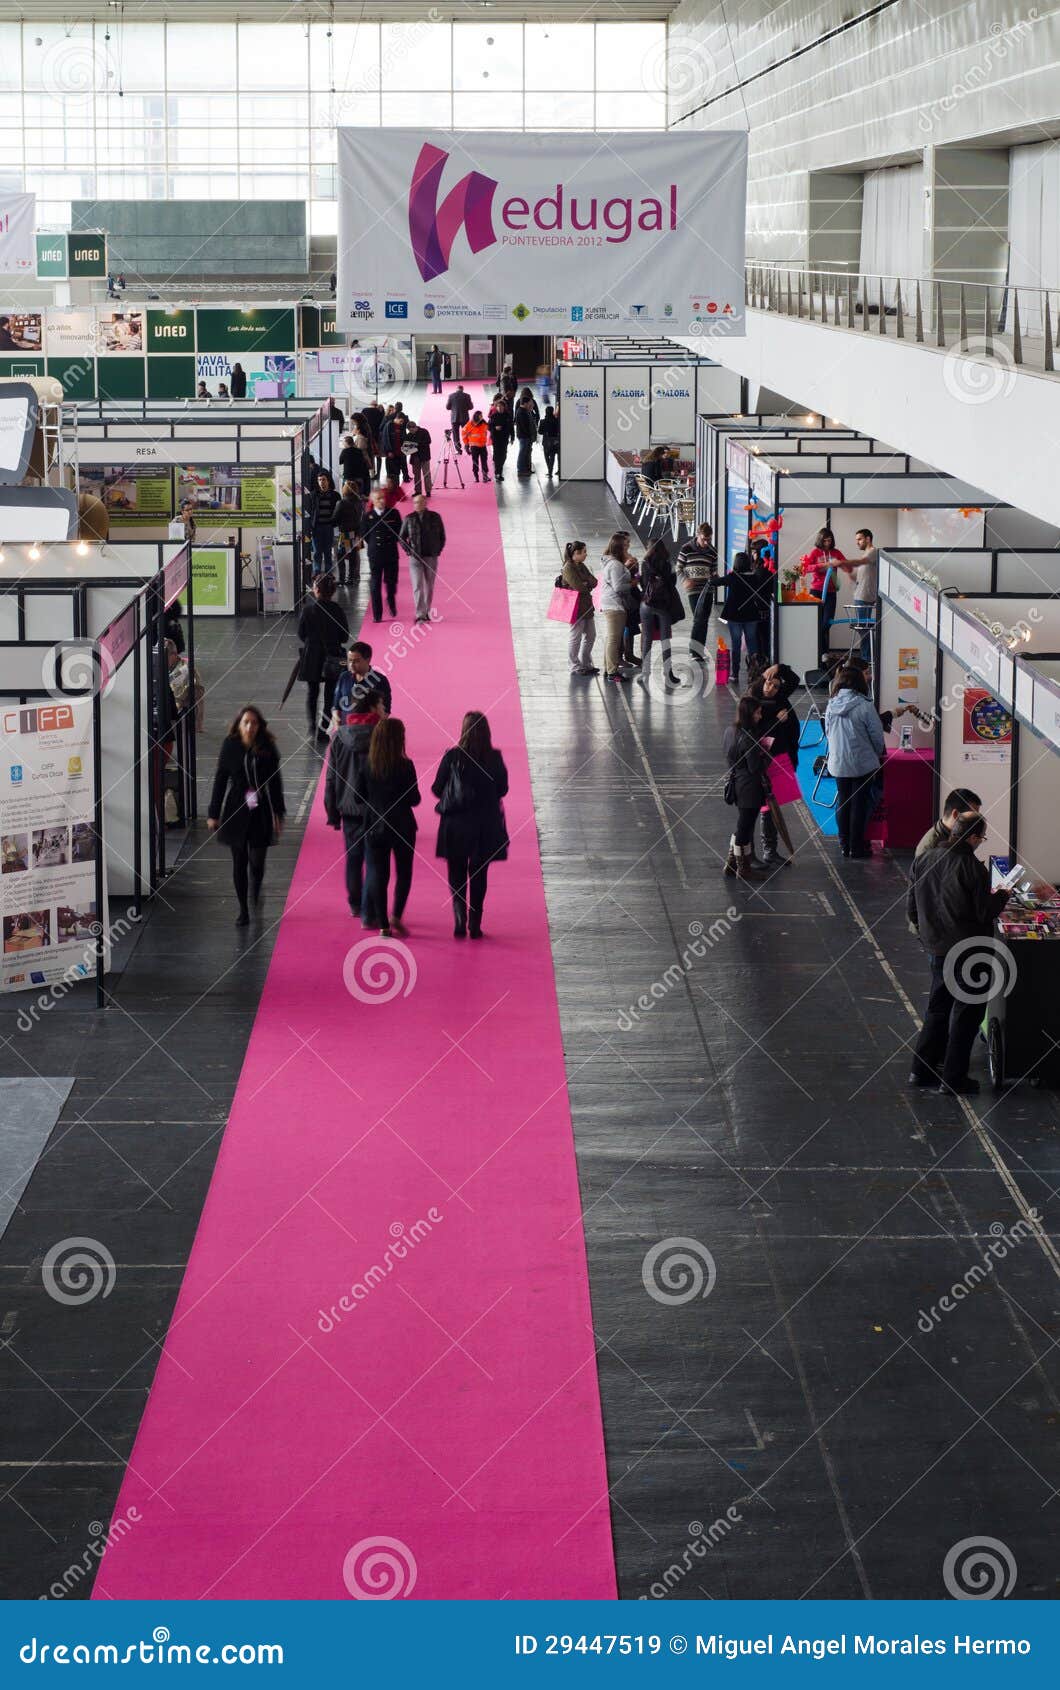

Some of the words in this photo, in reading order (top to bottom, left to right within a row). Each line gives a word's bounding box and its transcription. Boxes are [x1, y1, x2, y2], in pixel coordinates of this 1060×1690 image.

[502, 184, 677, 244] edugal
[502, 235, 574, 247] PONTEVEDRA
[577, 236, 603, 247] 2012
[42, 250, 62, 261] UNED
[74, 249, 100, 261] UNED
[389, 304, 403, 313] ICE
[154, 325, 187, 338] UNED
[323, 321, 336, 333] UN
[198, 366, 233, 377] MILITA
[573, 390, 599, 398] ALOHA
[620, 390, 645, 398] ALOHA
[665, 390, 690, 398] ALOHA
[136, 448, 157, 456] RESA
[4, 707, 71, 734] CIFP
